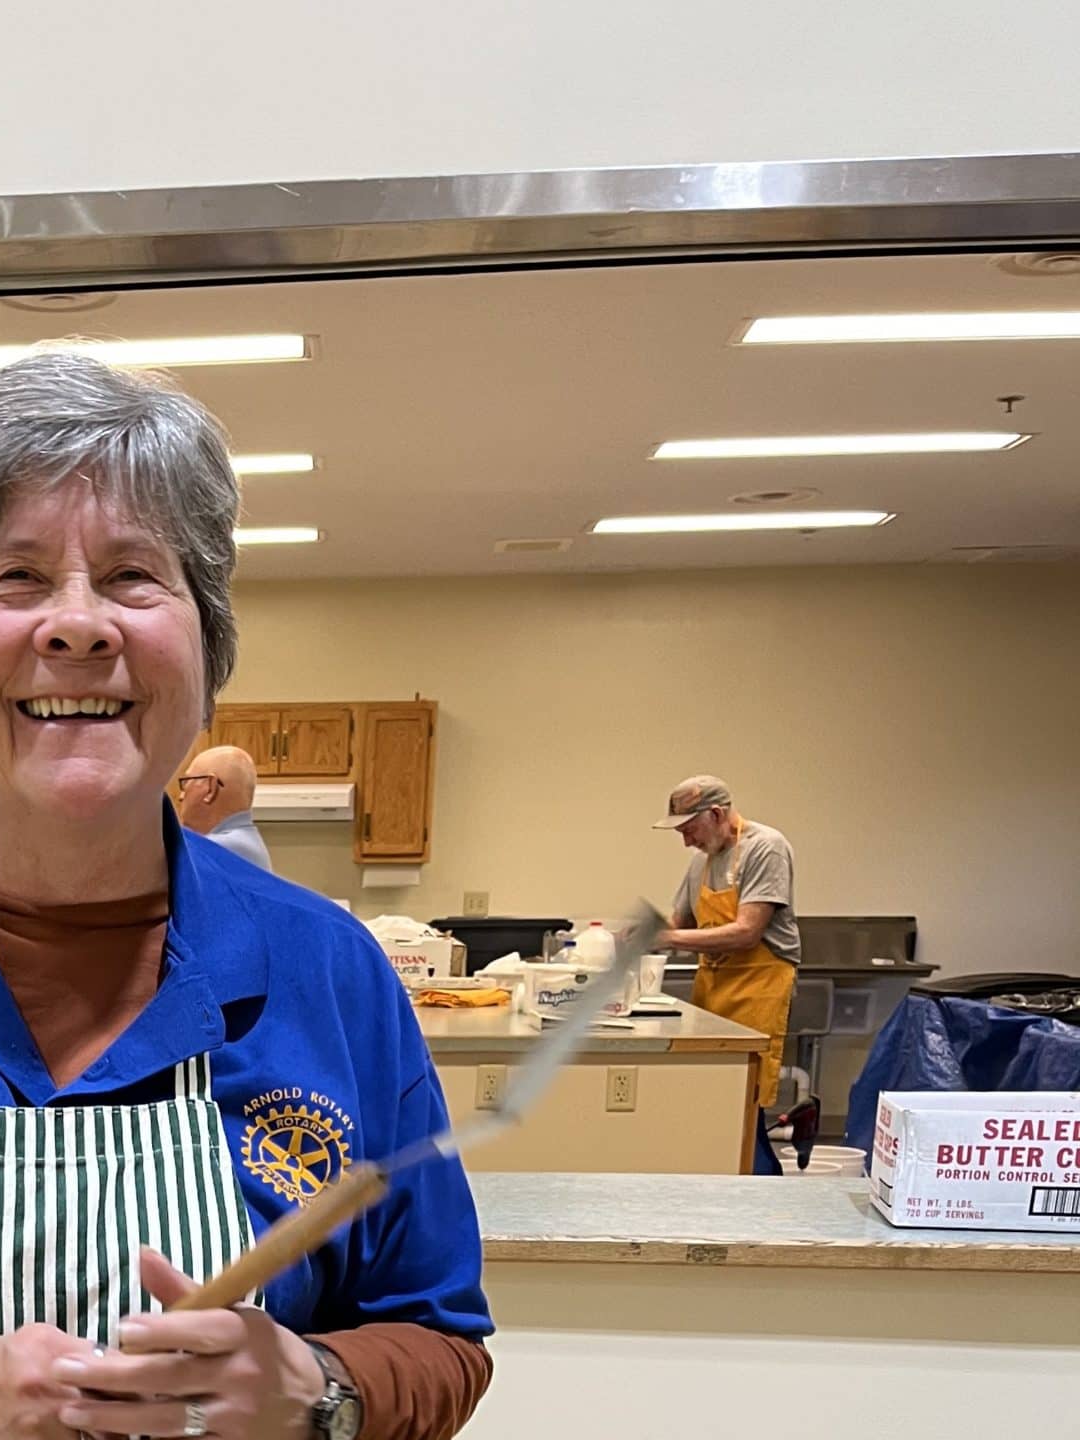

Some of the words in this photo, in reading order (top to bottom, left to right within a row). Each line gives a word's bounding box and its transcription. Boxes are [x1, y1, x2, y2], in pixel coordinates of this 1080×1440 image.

[389, 956, 426, 964] TISAN
[243, 1087, 302, 1117] ARNOLD
[310, 1091, 355, 1131] ROTARY
[276, 1116, 324, 1135] ROTARY
[937, 1145, 1044, 1168] BUTTER
[936, 1169, 990, 1181] PORTION
[998, 1171, 1055, 1183] CONTROL
[907, 1198, 921, 1207] NET
[906, 1208, 921, 1217] 720
[925, 1209, 941, 1218] CUP
[945, 1210, 985, 1220] SERVINGS
